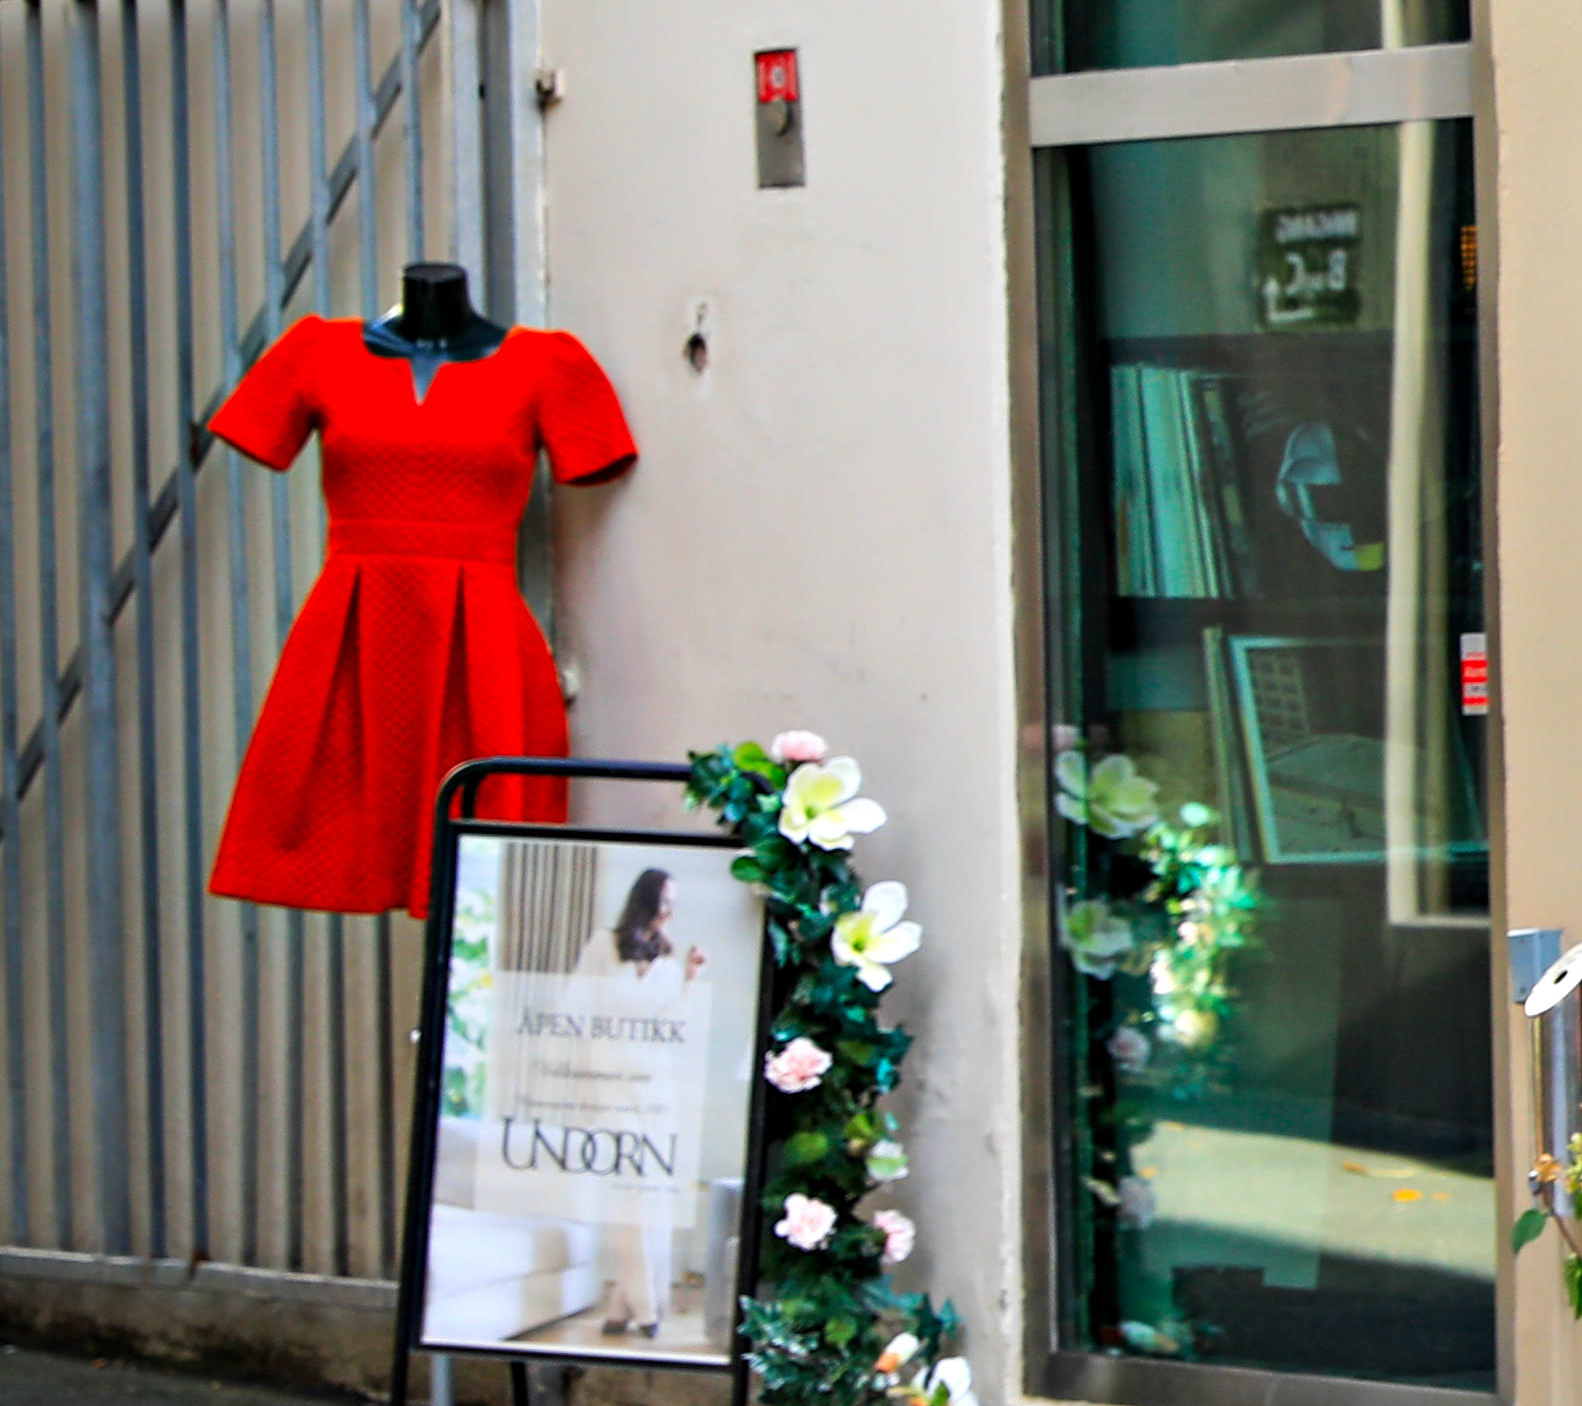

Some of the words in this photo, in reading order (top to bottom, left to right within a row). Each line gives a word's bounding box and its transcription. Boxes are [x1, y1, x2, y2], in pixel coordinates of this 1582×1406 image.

[515, 1006, 586, 1038] ÅPEN
[591, 1016, 687, 1043] BUTIKK
[503, 1117, 679, 1176] UNDORN
